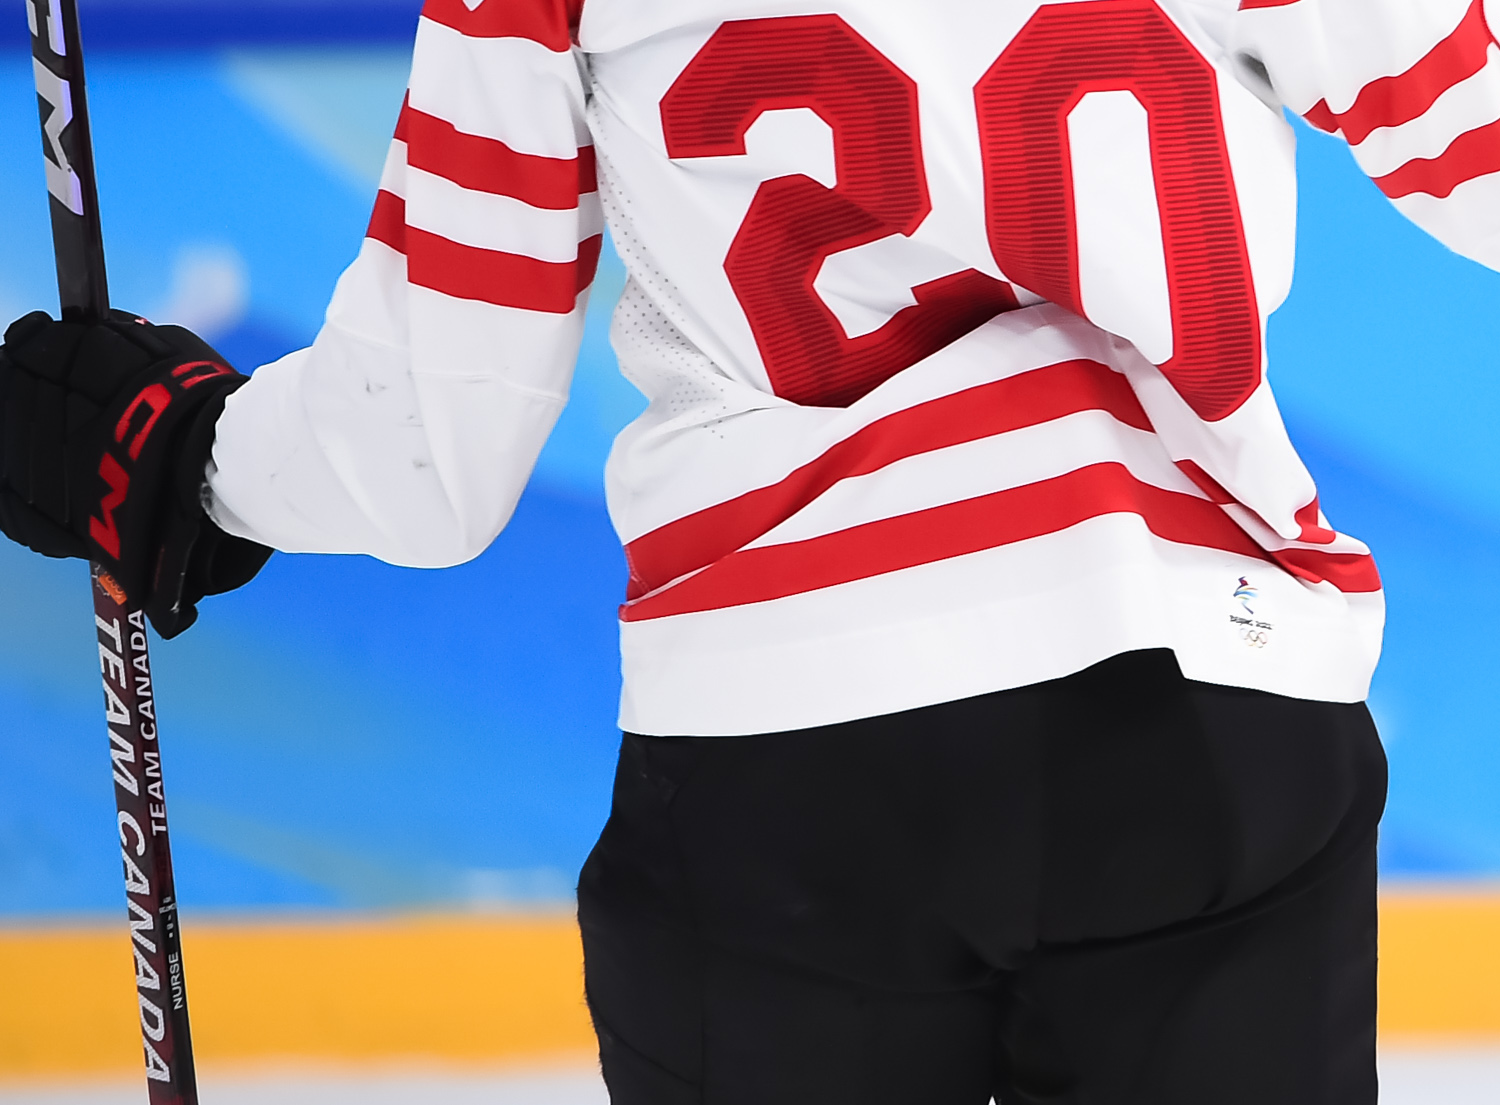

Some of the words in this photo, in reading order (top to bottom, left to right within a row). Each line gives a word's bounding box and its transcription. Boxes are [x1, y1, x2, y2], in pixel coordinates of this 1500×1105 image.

[89, 360, 236, 561] CCM
[128, 609, 157, 741] CANADA
[95, 613, 139, 797] TEAM
[117, 810, 171, 1084] CANADA
[143, 750, 168, 837] TEAM
[168, 951, 183, 1010] NURSE
